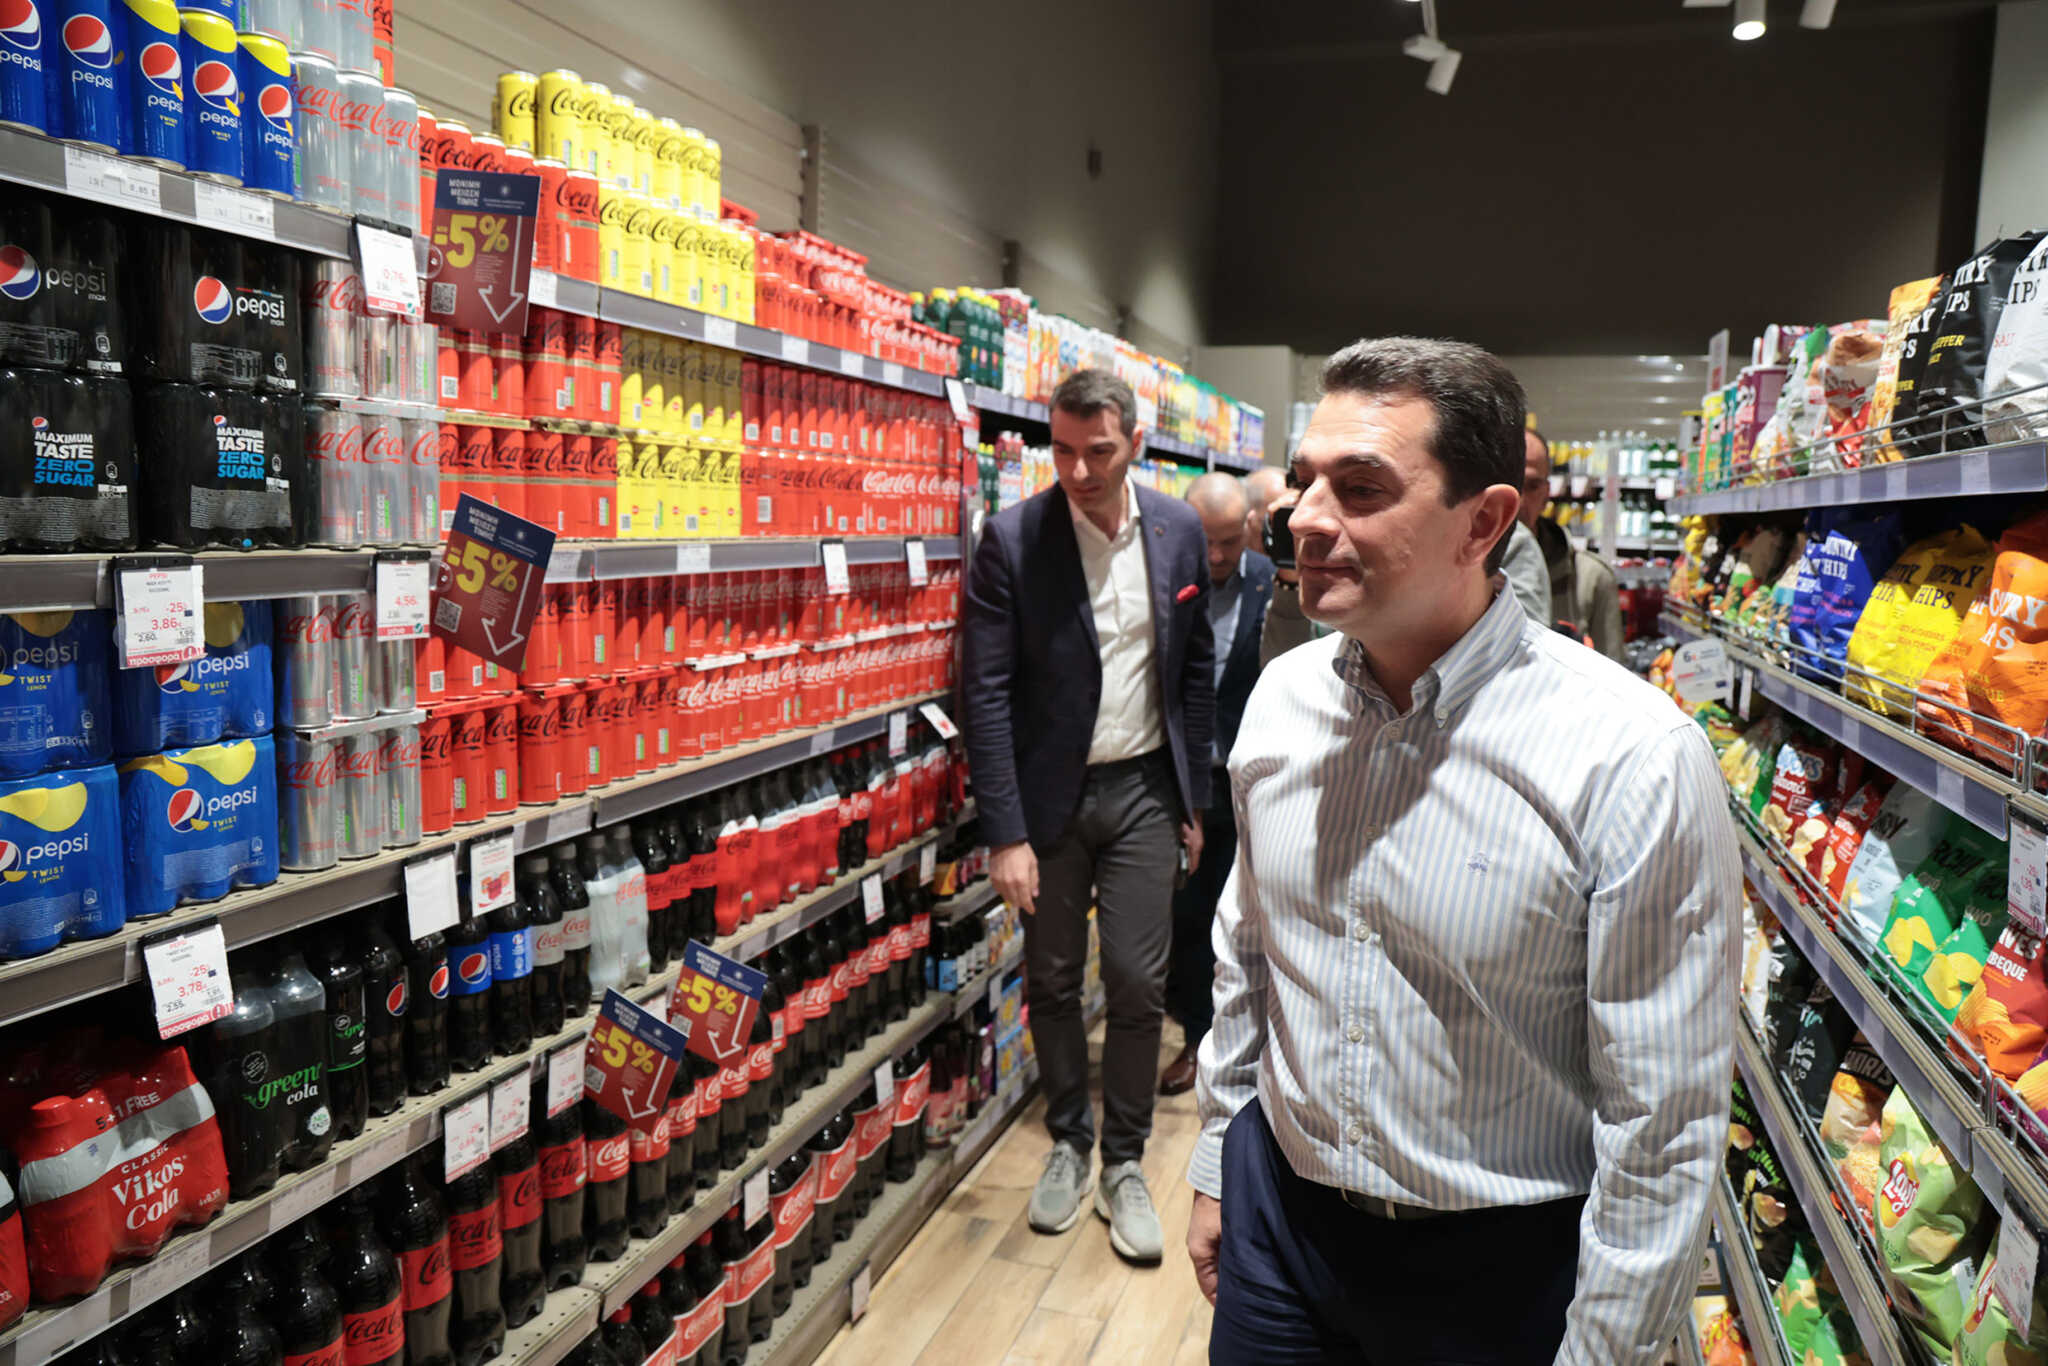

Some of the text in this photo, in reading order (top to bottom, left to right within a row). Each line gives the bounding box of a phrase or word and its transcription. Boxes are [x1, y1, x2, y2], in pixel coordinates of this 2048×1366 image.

[72, 70, 114, 90] pepsi
[434, 213, 510, 269] -5%
[45, 267, 106, 296] pepsi
[236, 295, 285, 320] pepsi
[34, 431, 93, 443] MAXIMUM
[216, 436, 265, 453] TASTE
[34, 441, 94, 460] TASTE
[217, 451, 265, 466] ZERO
[34, 457, 95, 473] ZERO
[217, 464, 265, 480] SUGAR
[33, 470, 95, 487] SUGAR
[447, 540, 519, 595] -5%
[13, 641, 79, 671] pepsi
[197, 651, 249, 679] pepsi
[19, 674, 52, 685] TWIST
[204, 680, 229, 691] TWIST
[207, 786, 257, 816] pepsi
[212, 816, 237, 828] TWIST
[26, 832, 88, 865] pepsi
[32, 866, 64, 878] TWIST
[679, 974, 737, 1015] -5%
[595, 1026, 654, 1073] -5%
[247, 1062, 322, 1110] green
[286, 1083, 319, 1105] cola
[95, 1091, 161, 1131] 5+1 FREE
[120, 1143, 169, 1174] CLASSIC
[112, 1156, 185, 1207] Vikos
[126, 1187, 179, 1230] Cola
